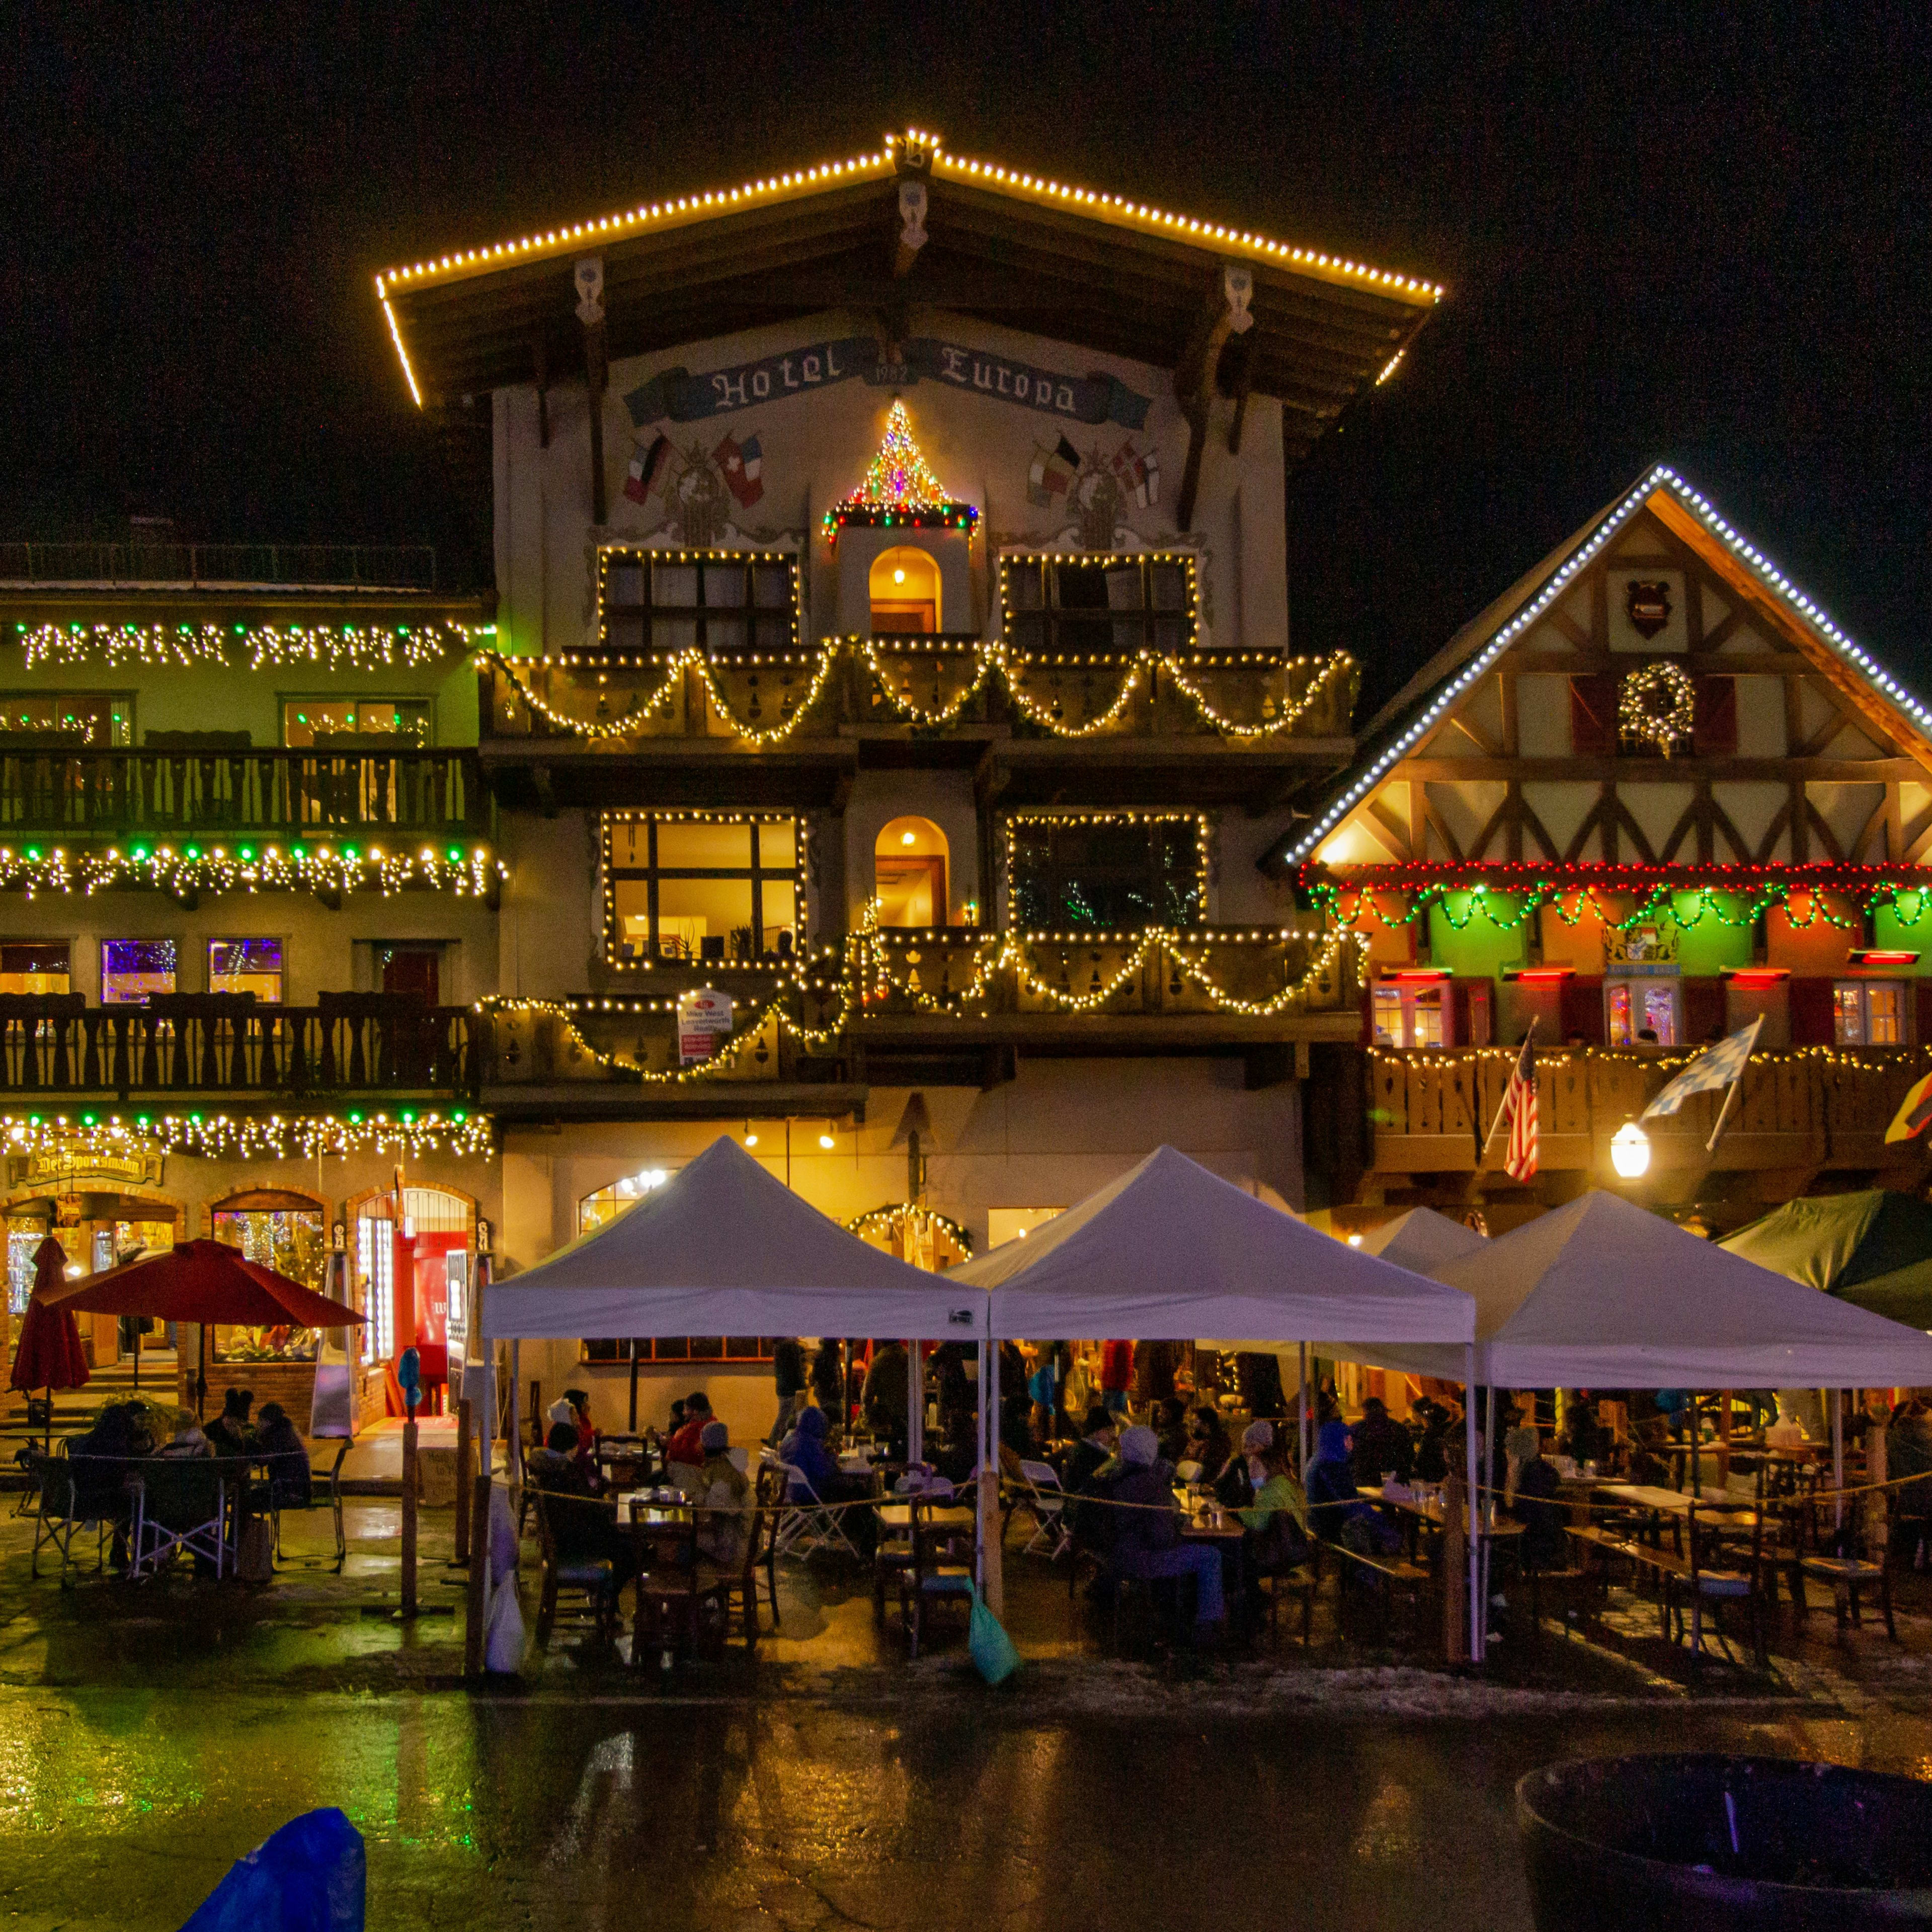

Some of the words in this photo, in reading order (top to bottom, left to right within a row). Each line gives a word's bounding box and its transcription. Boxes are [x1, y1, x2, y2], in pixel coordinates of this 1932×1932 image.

[712, 346, 843, 407] Hotel
[942, 347, 1076, 412] Europa
[38, 1156, 61, 1173] Der
[64, 1151, 139, 1173] Sportsmann
